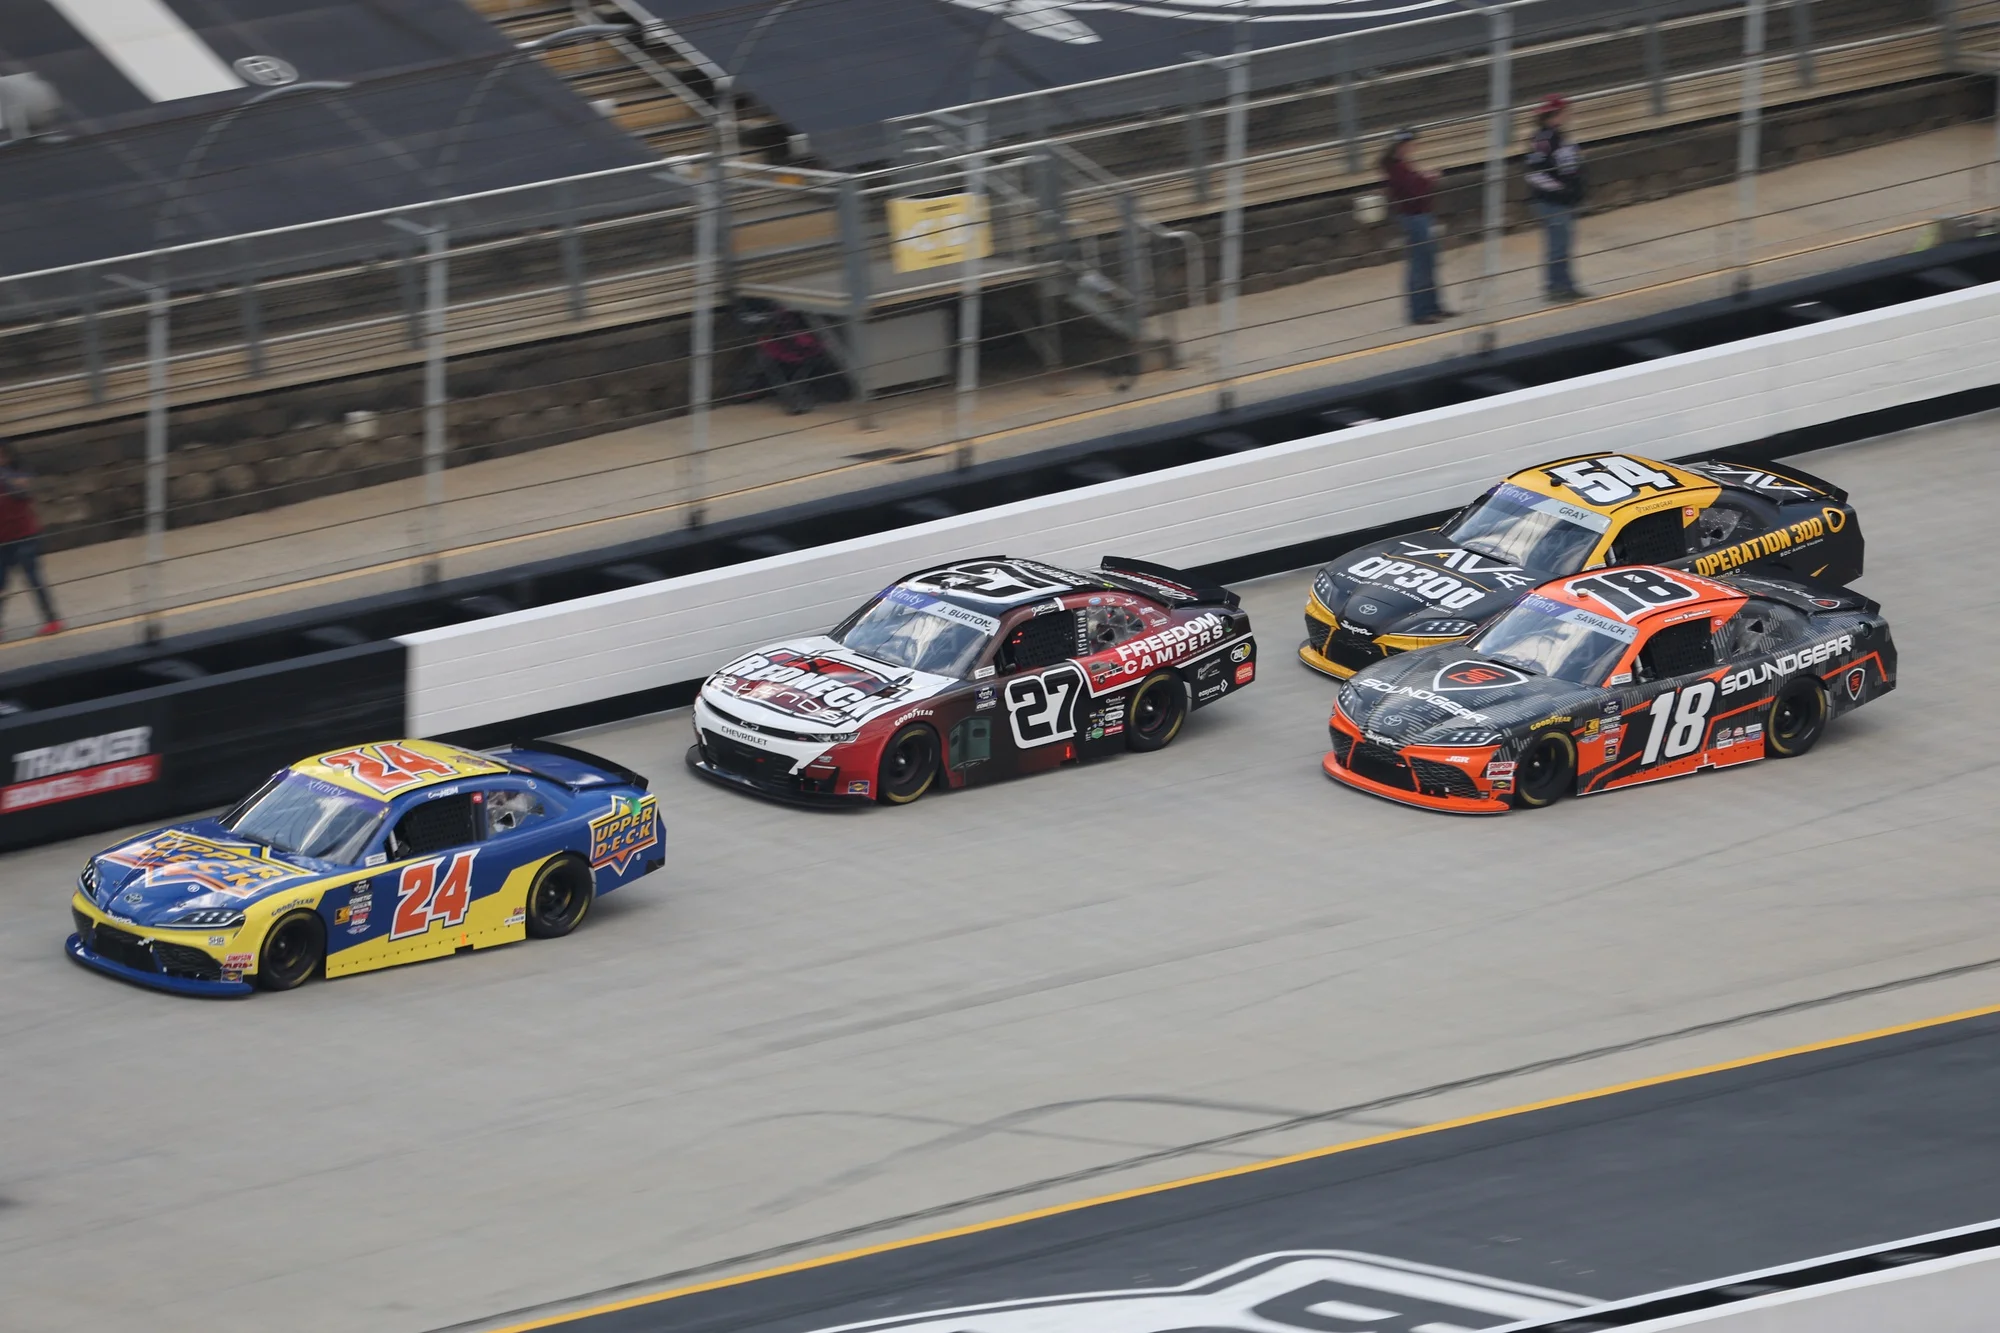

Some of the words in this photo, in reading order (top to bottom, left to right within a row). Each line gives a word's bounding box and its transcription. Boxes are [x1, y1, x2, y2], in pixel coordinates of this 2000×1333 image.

[1500, 485, 1534, 502] xfinity
[1549, 454, 1677, 505] 54
[1559, 506, 1588, 521] GRAY
[1695, 528, 1791, 577] OPERATION
[1791, 517, 1823, 545] 300
[887, 586, 925, 606] xfinity
[1348, 556, 1485, 610] OP300
[1526, 597, 1560, 613] xfinity
[1563, 569, 1700, 623] 18
[937, 605, 946, 614] J.
[948, 608, 992, 628] BURTON
[1115, 612, 1220, 662] FREEDOM
[1573, 612, 1627, 636] SAWALICH
[1124, 624, 1224, 674] CAMPERS
[1720, 635, 1853, 696] SOUNDGEAR
[715, 652, 896, 720] REDNECK
[1004, 664, 1085, 749] 27
[1359, 678, 1490, 723] SOUNDGEAR
[721, 725, 768, 746] CHEVROLET
[895, 708, 934, 727] GOODYEAR
[1530, 715, 1572, 731] GOODYEAR
[1640, 681, 1715, 765] 18
[305, 778, 348, 798] xfinity
[320, 742, 460, 794] 24
[594, 804, 654, 843] UPPER
[154, 838, 283, 881] UPPER
[271, 897, 315, 918] GOODYEAR
[388, 848, 481, 942] 24
